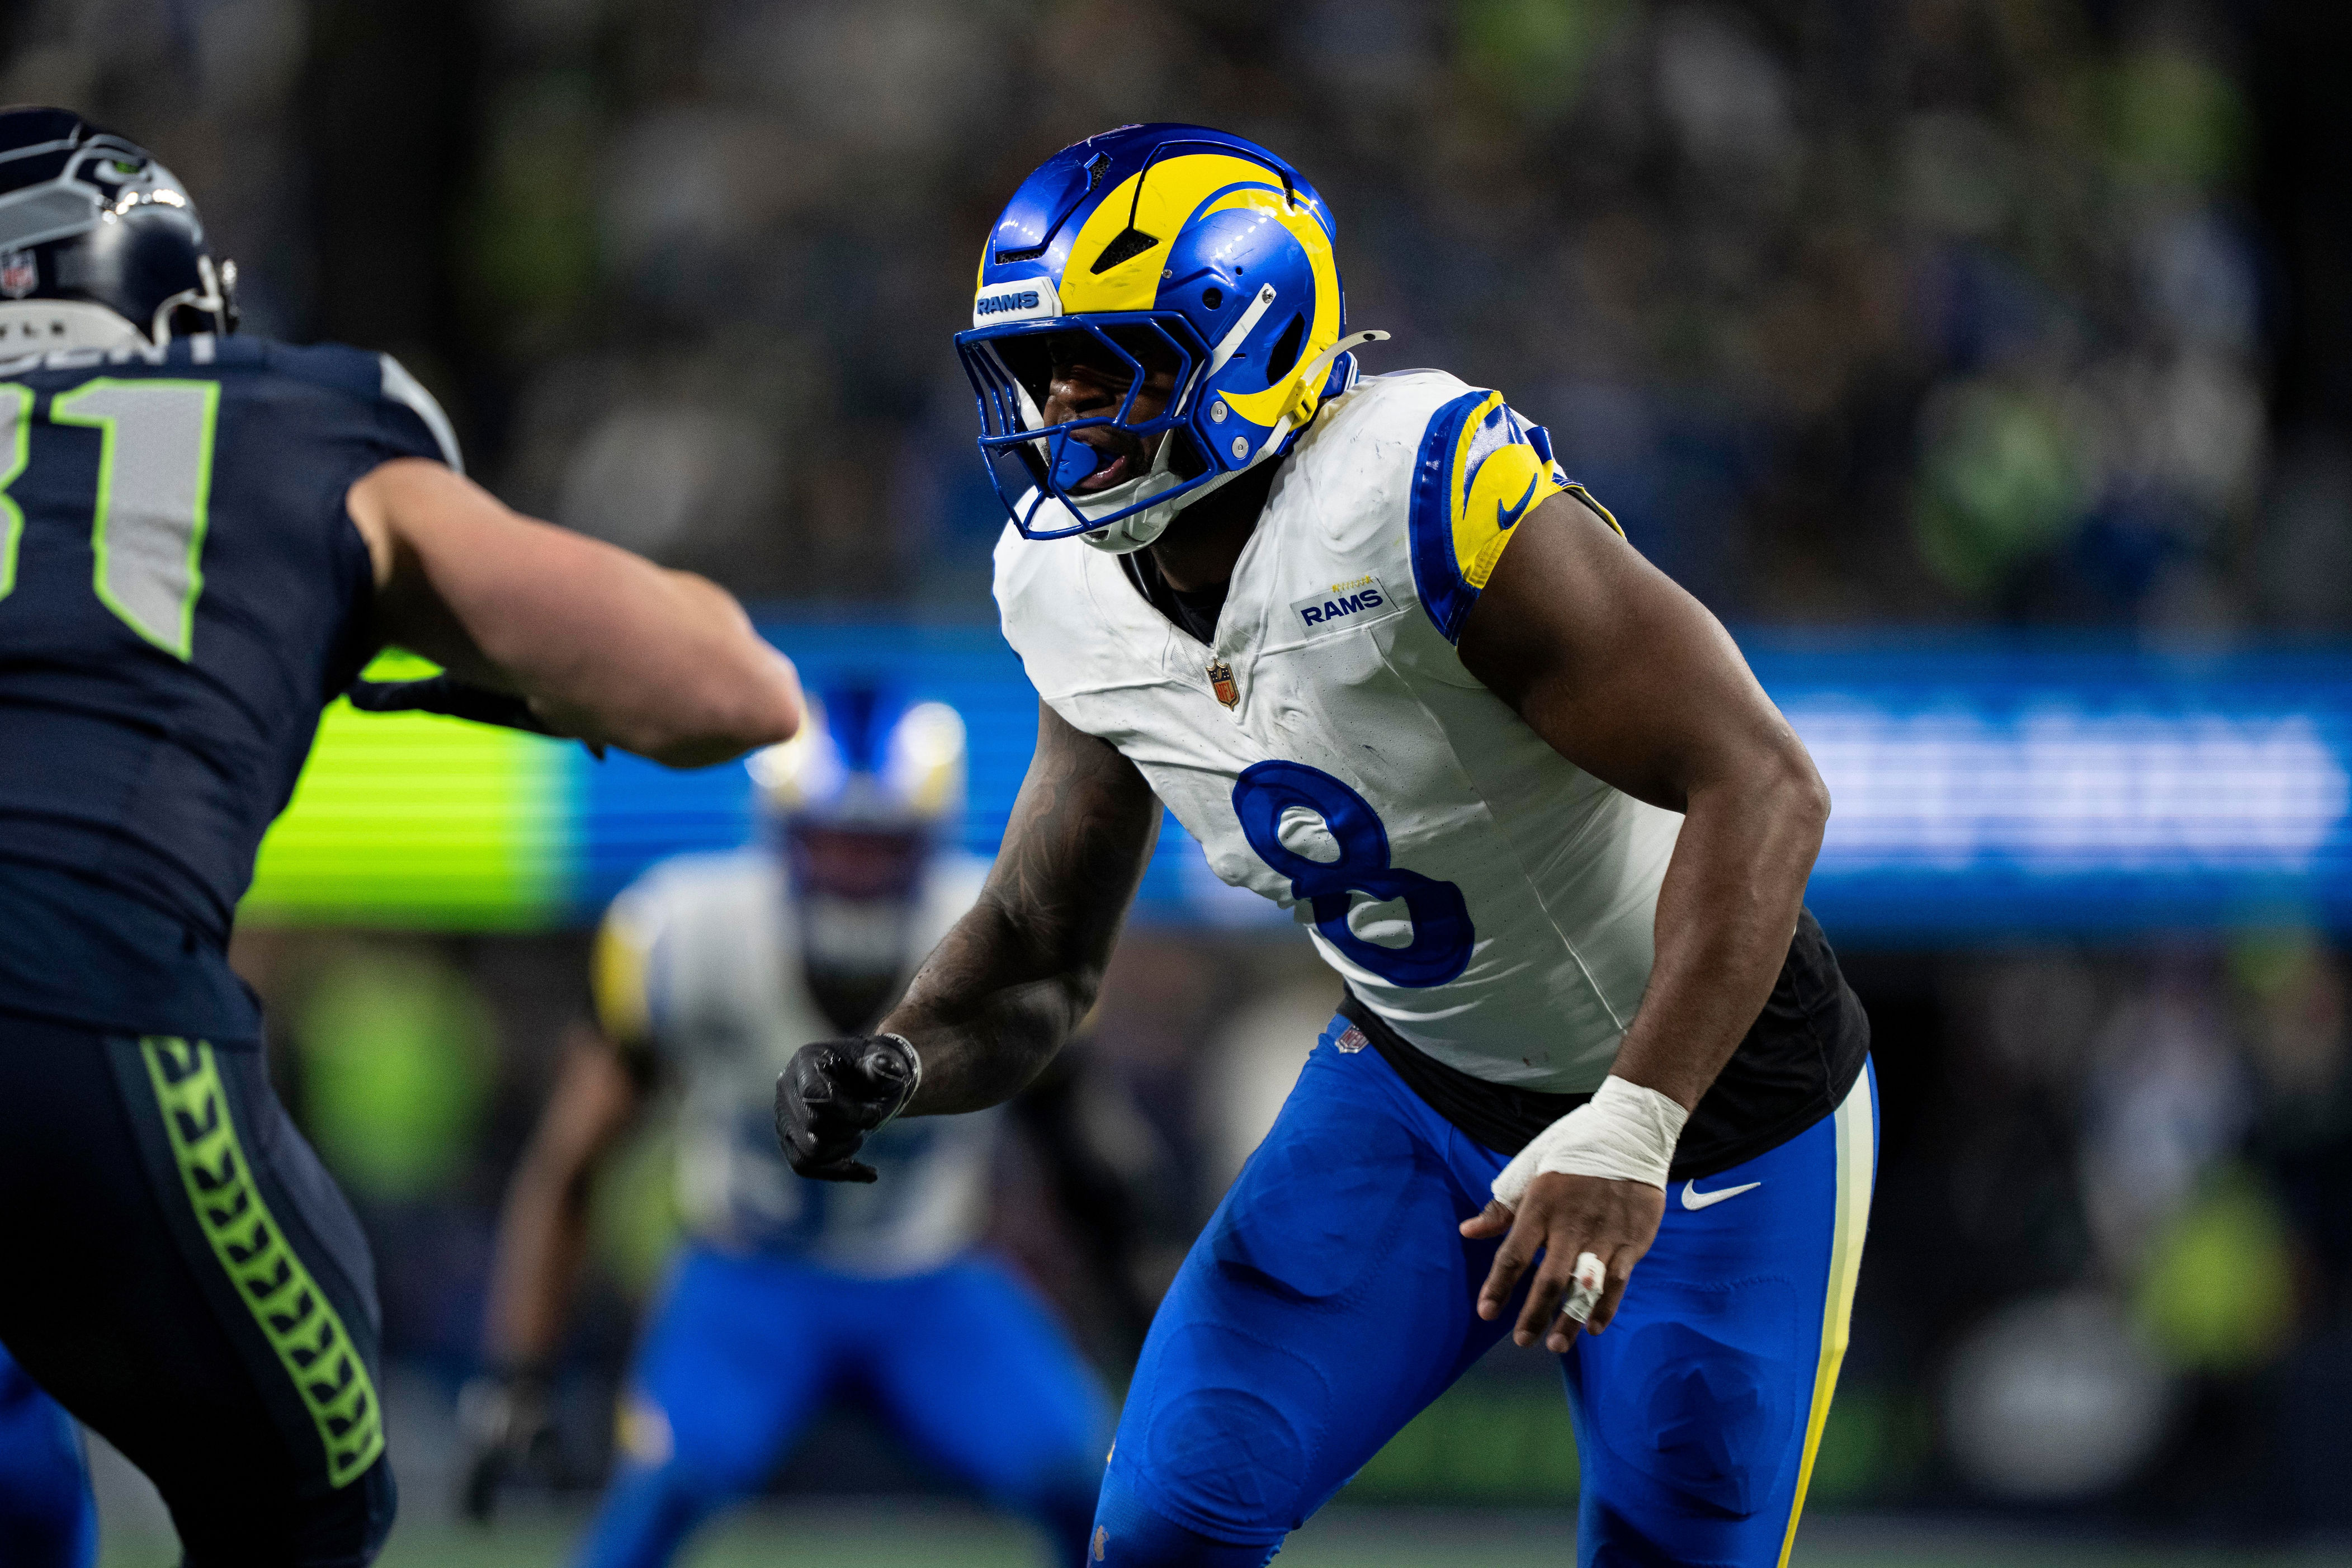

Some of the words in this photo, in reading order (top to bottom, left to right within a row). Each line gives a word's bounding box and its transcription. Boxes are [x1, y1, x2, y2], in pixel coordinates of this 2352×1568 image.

[977, 291, 1039, 315] RAMS
[0, 376, 221, 663] 1
[1301, 589, 1383, 626] RAMS
[1215, 682, 1235, 702] NFL
[1232, 759, 1475, 988] 8
